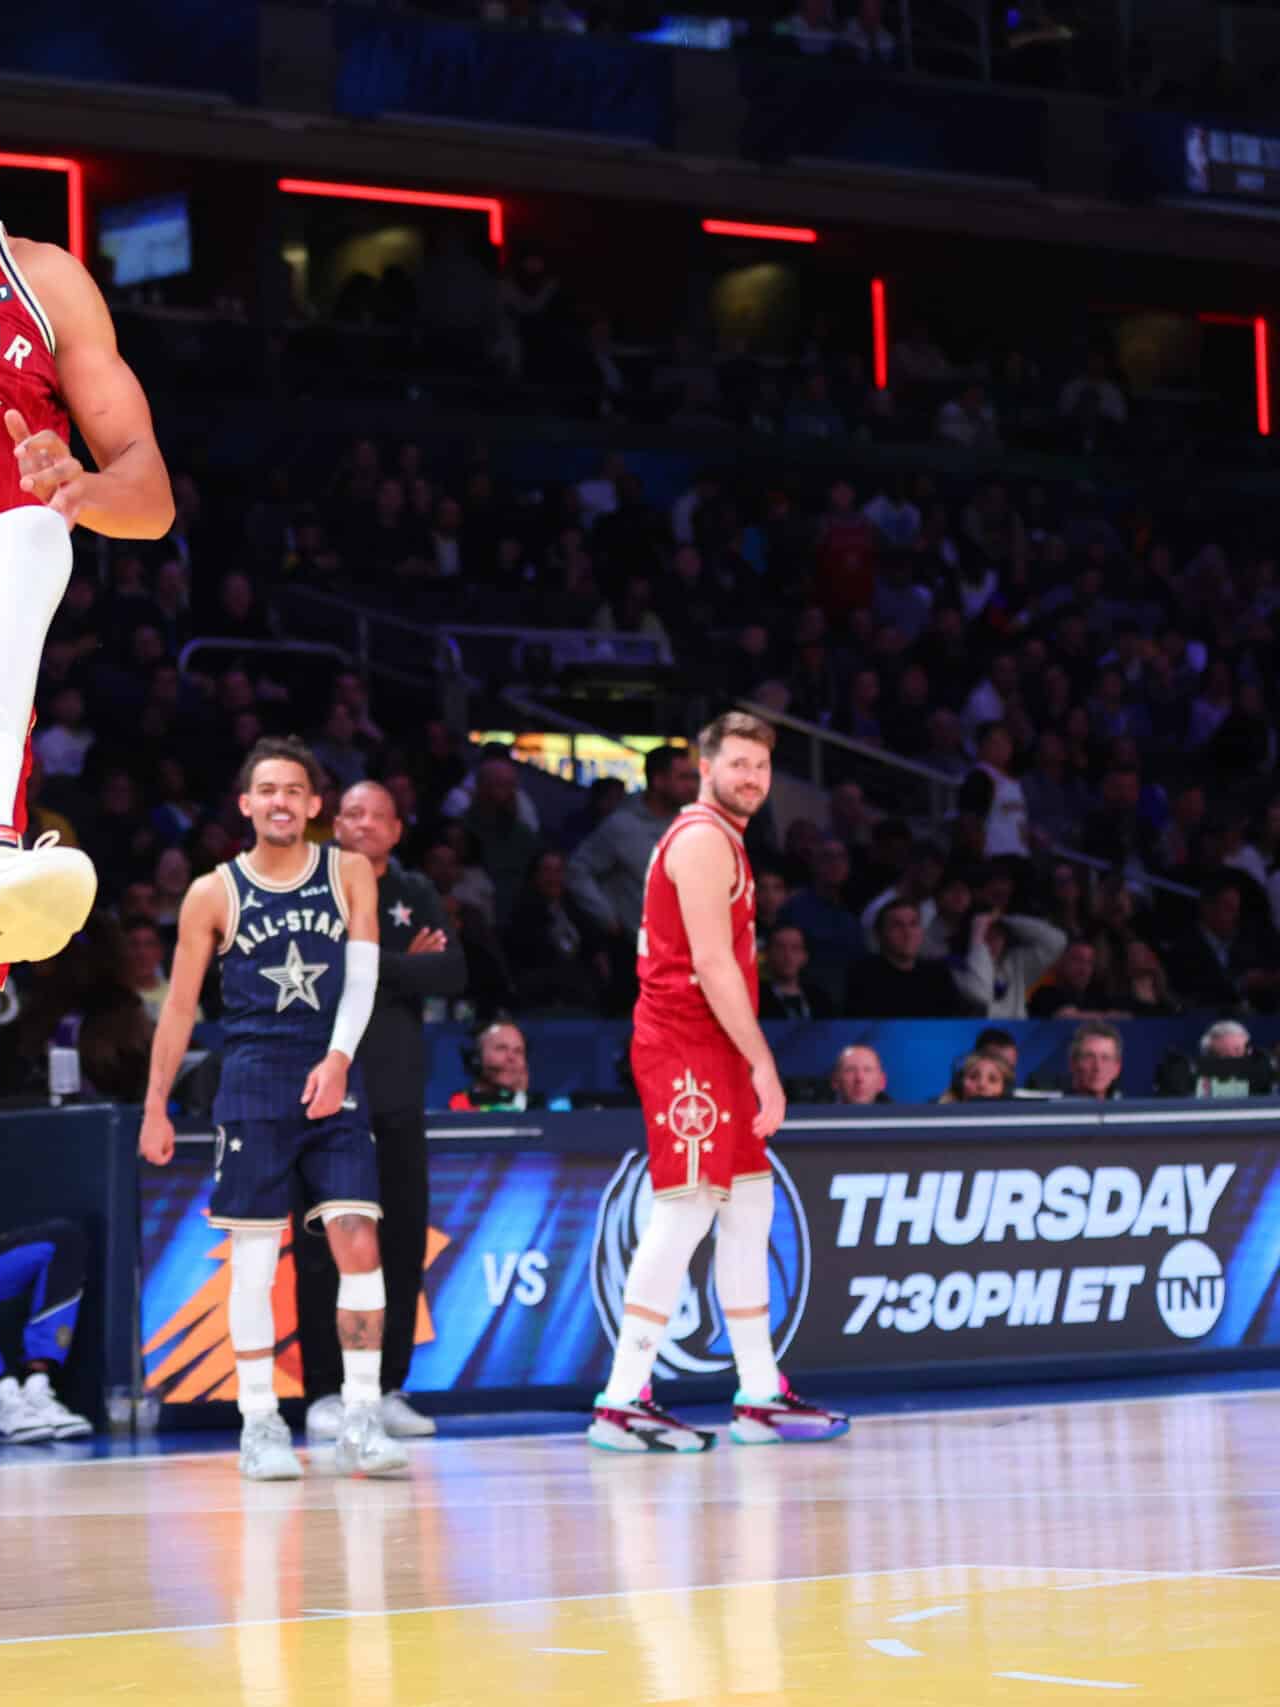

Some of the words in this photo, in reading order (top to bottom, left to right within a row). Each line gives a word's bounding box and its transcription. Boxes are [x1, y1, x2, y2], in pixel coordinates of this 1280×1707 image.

[235, 909, 345, 955] ALL-STAR
[828, 1163, 1237, 1248] THURSDAY
[482, 1250, 549, 1307] VS
[842, 1269, 1064, 1335] 7:30PM
[1062, 1264, 1146, 1325] ET
